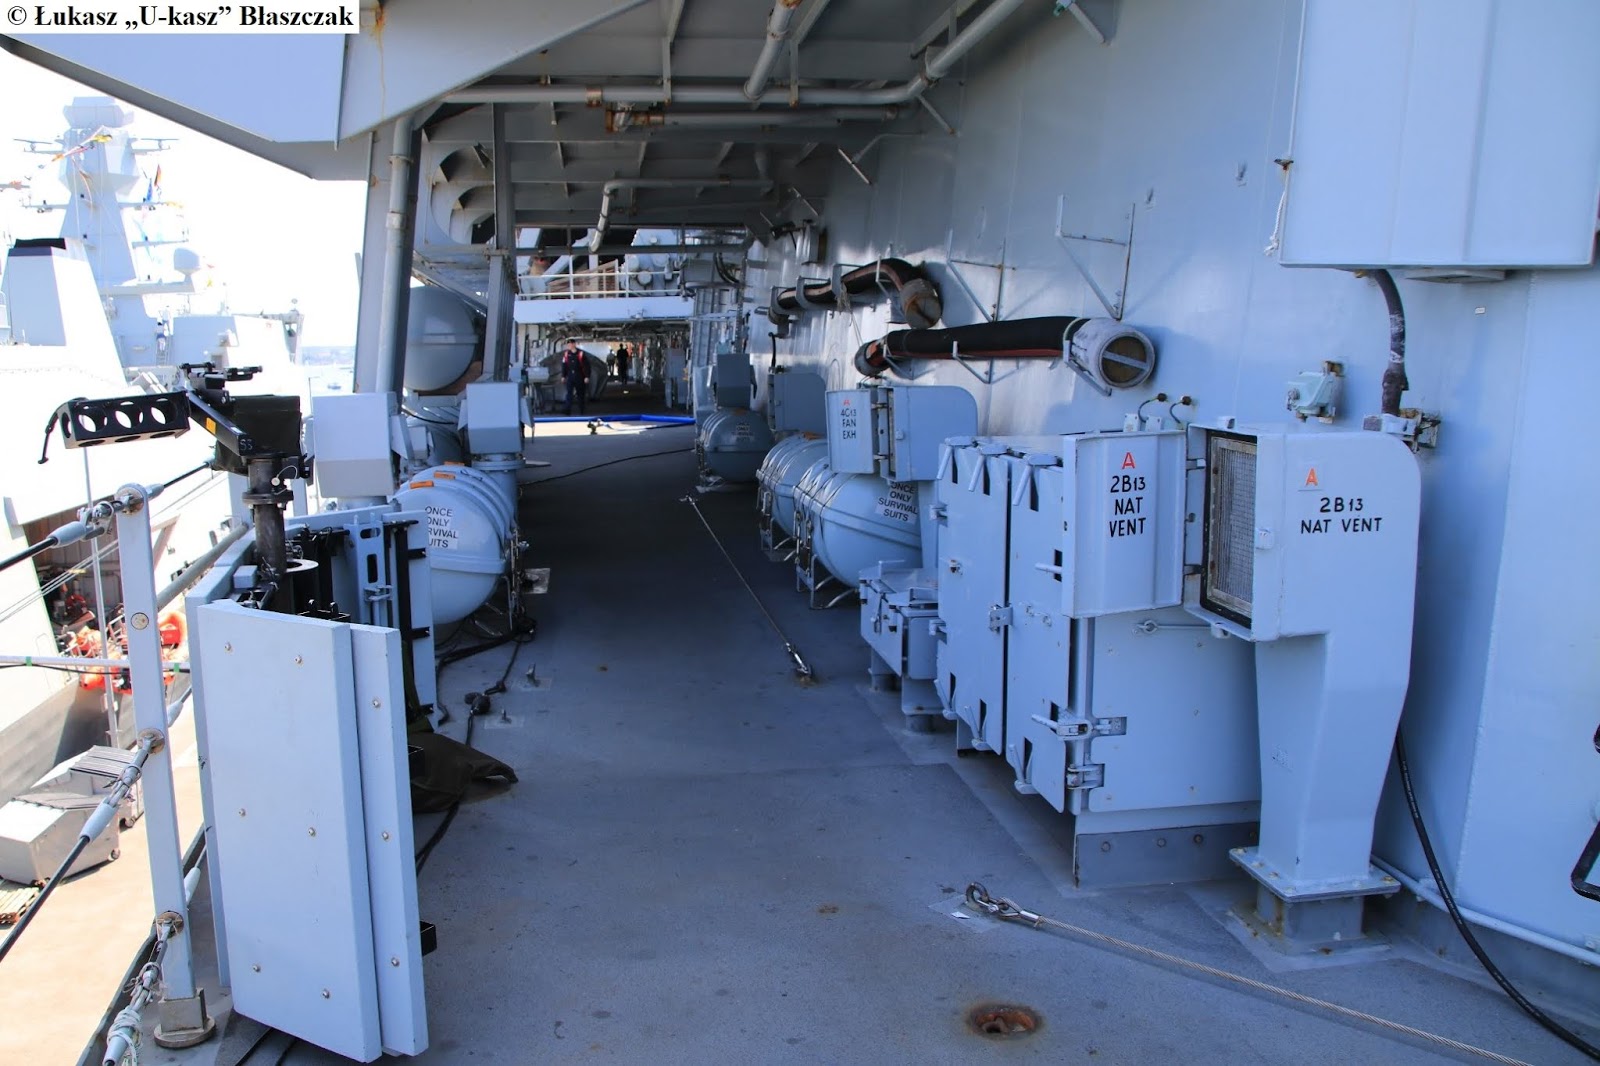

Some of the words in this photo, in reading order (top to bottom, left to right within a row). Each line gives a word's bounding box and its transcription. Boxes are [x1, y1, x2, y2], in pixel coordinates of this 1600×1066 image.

[842, 418, 856, 427] FAN
[842, 430, 856, 439] EXH
[1122, 452, 1136, 469] A
[1110, 475, 1146, 493] 2B13
[1305, 468, 1318, 486] A
[889, 491, 911, 503] ONLY
[1114, 496, 1143, 515] NAT
[425, 506, 453, 517] ONCE
[878, 497, 918, 515] SURVIVAL
[883, 508, 909, 522] SUITS
[1109, 517, 1146, 537] VENT
[1300, 519, 1332, 534] NAT
[1341, 517, 1383, 533] VENT
[428, 538, 449, 548] UITS
